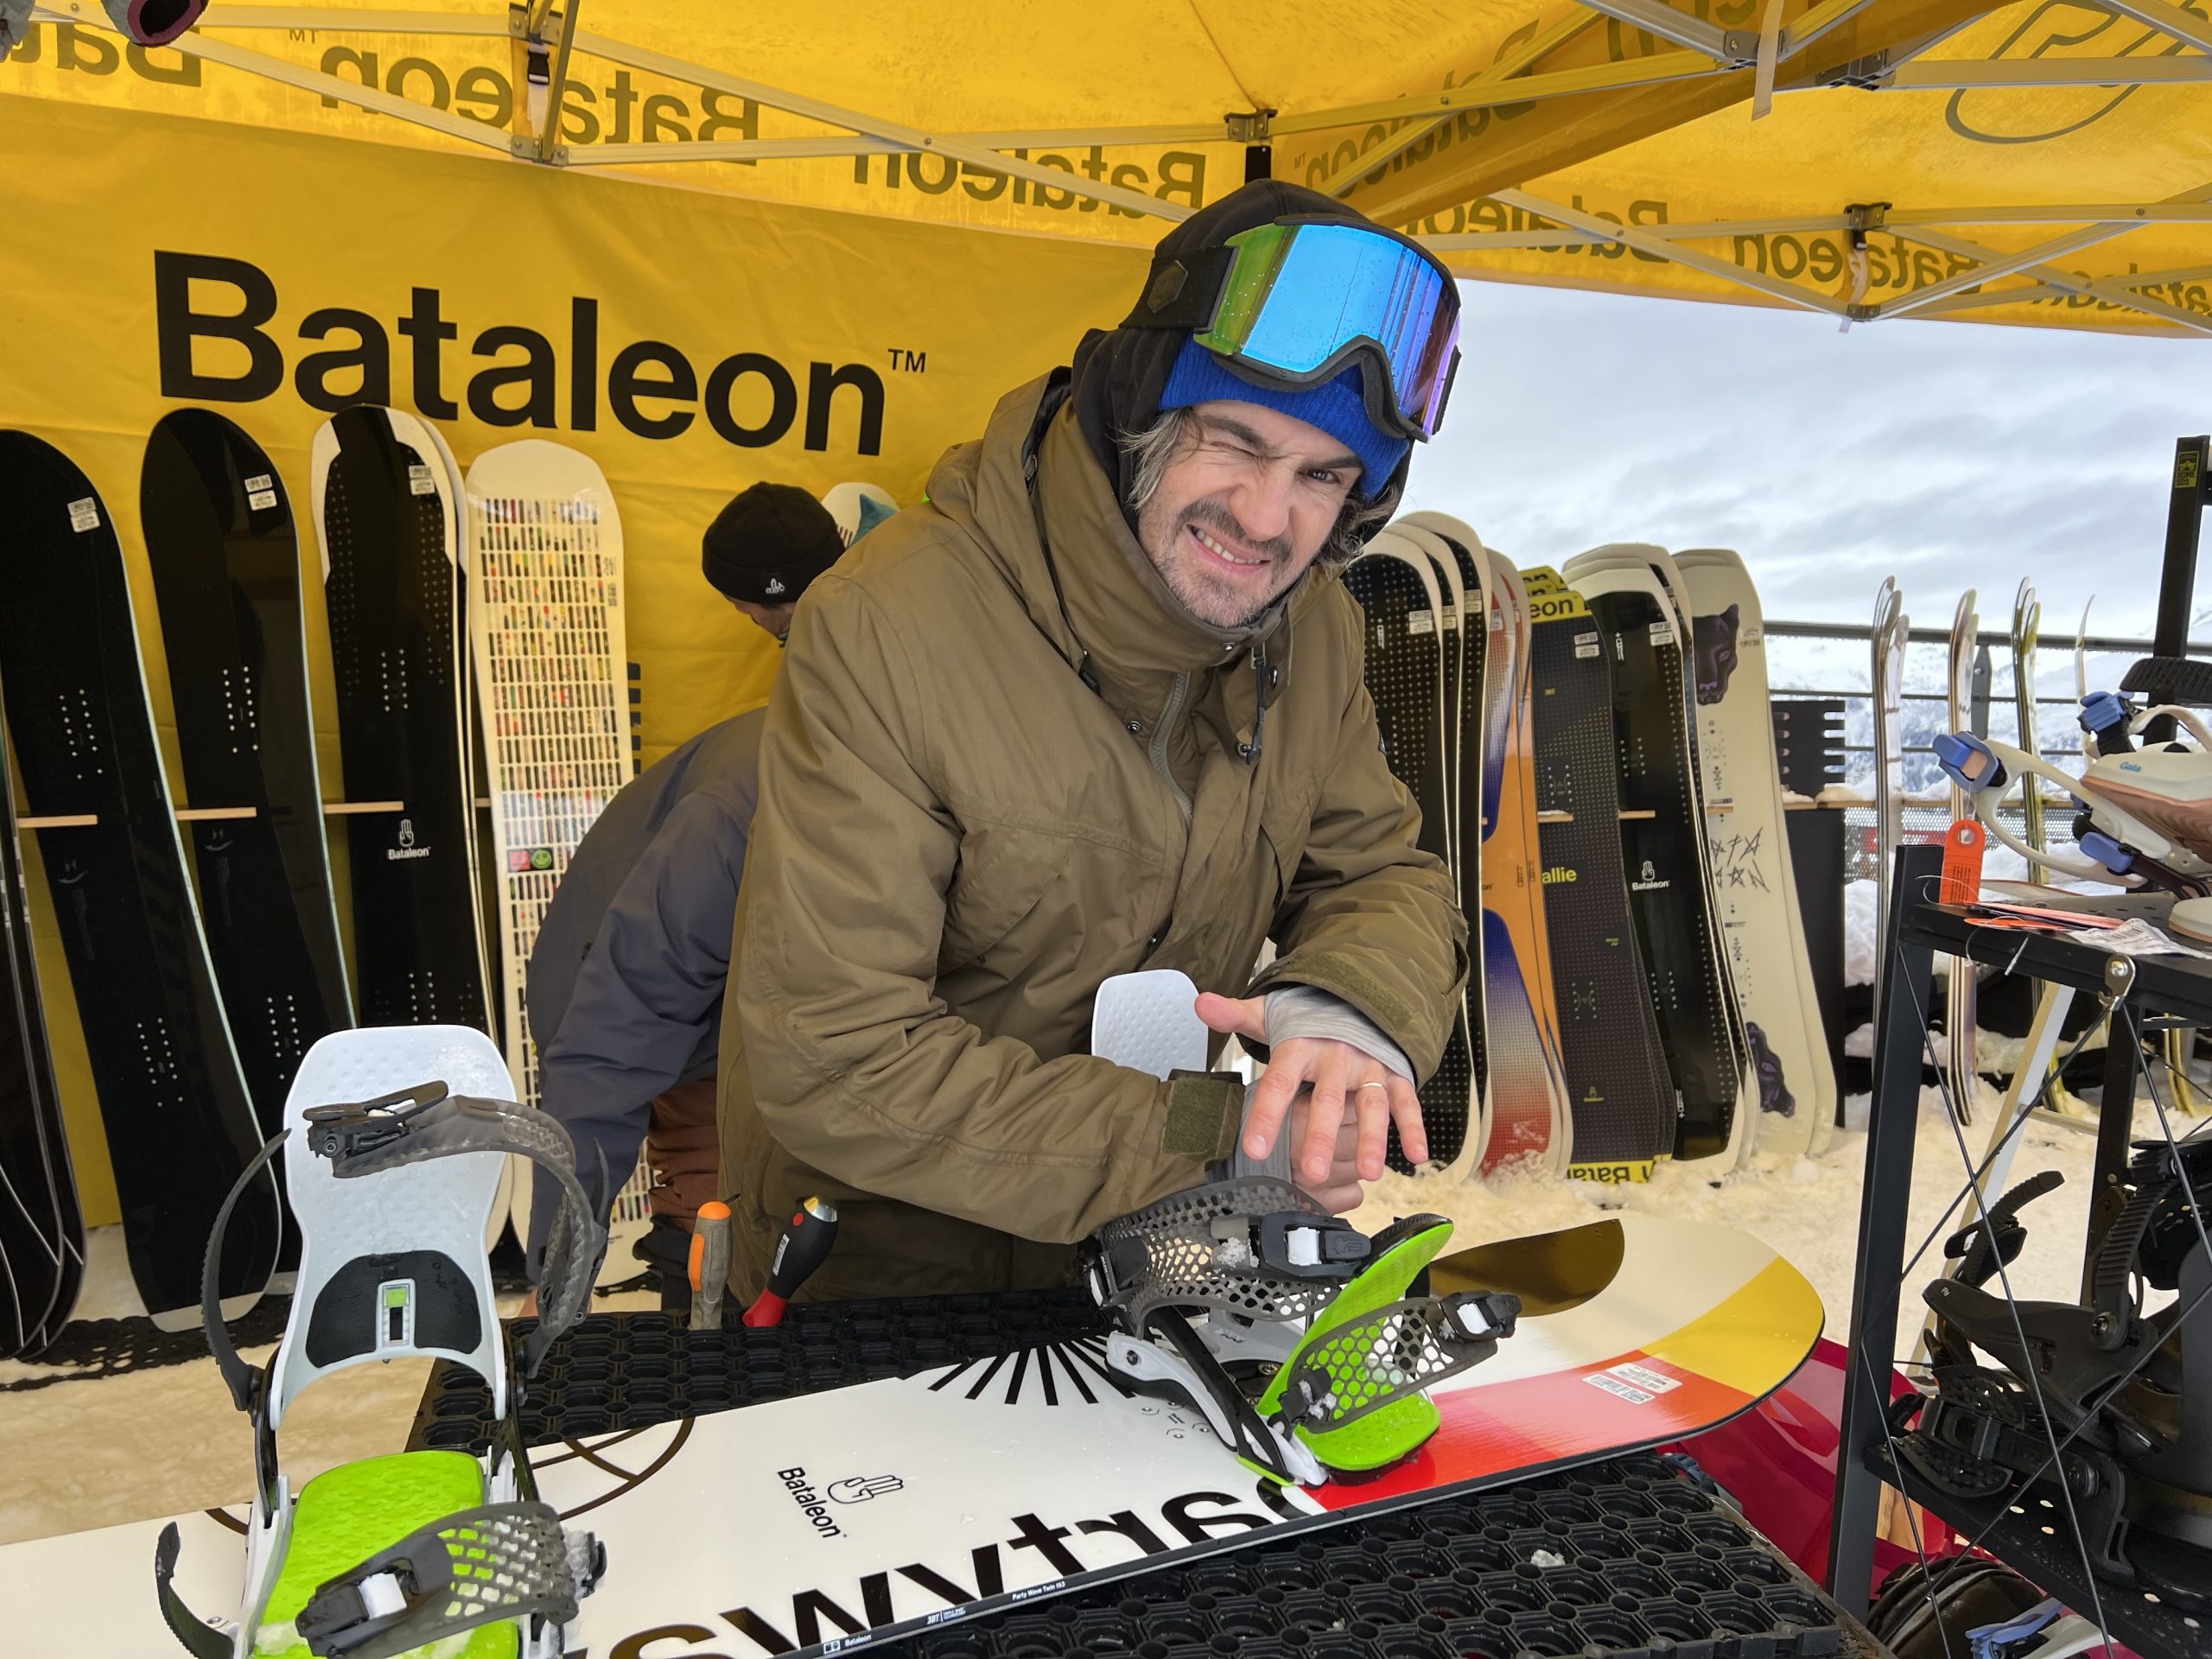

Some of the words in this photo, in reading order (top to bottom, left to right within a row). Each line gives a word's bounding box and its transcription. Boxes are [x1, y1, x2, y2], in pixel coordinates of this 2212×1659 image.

[777, 1467, 842, 1538] Bataleon
[1012, 1591, 1027, 1601] Party
[1027, 1587, 1042, 1597] Wave
[1042, 1583, 1055, 1592] Twin
[844, 1634, 872, 1647] Bataleon
